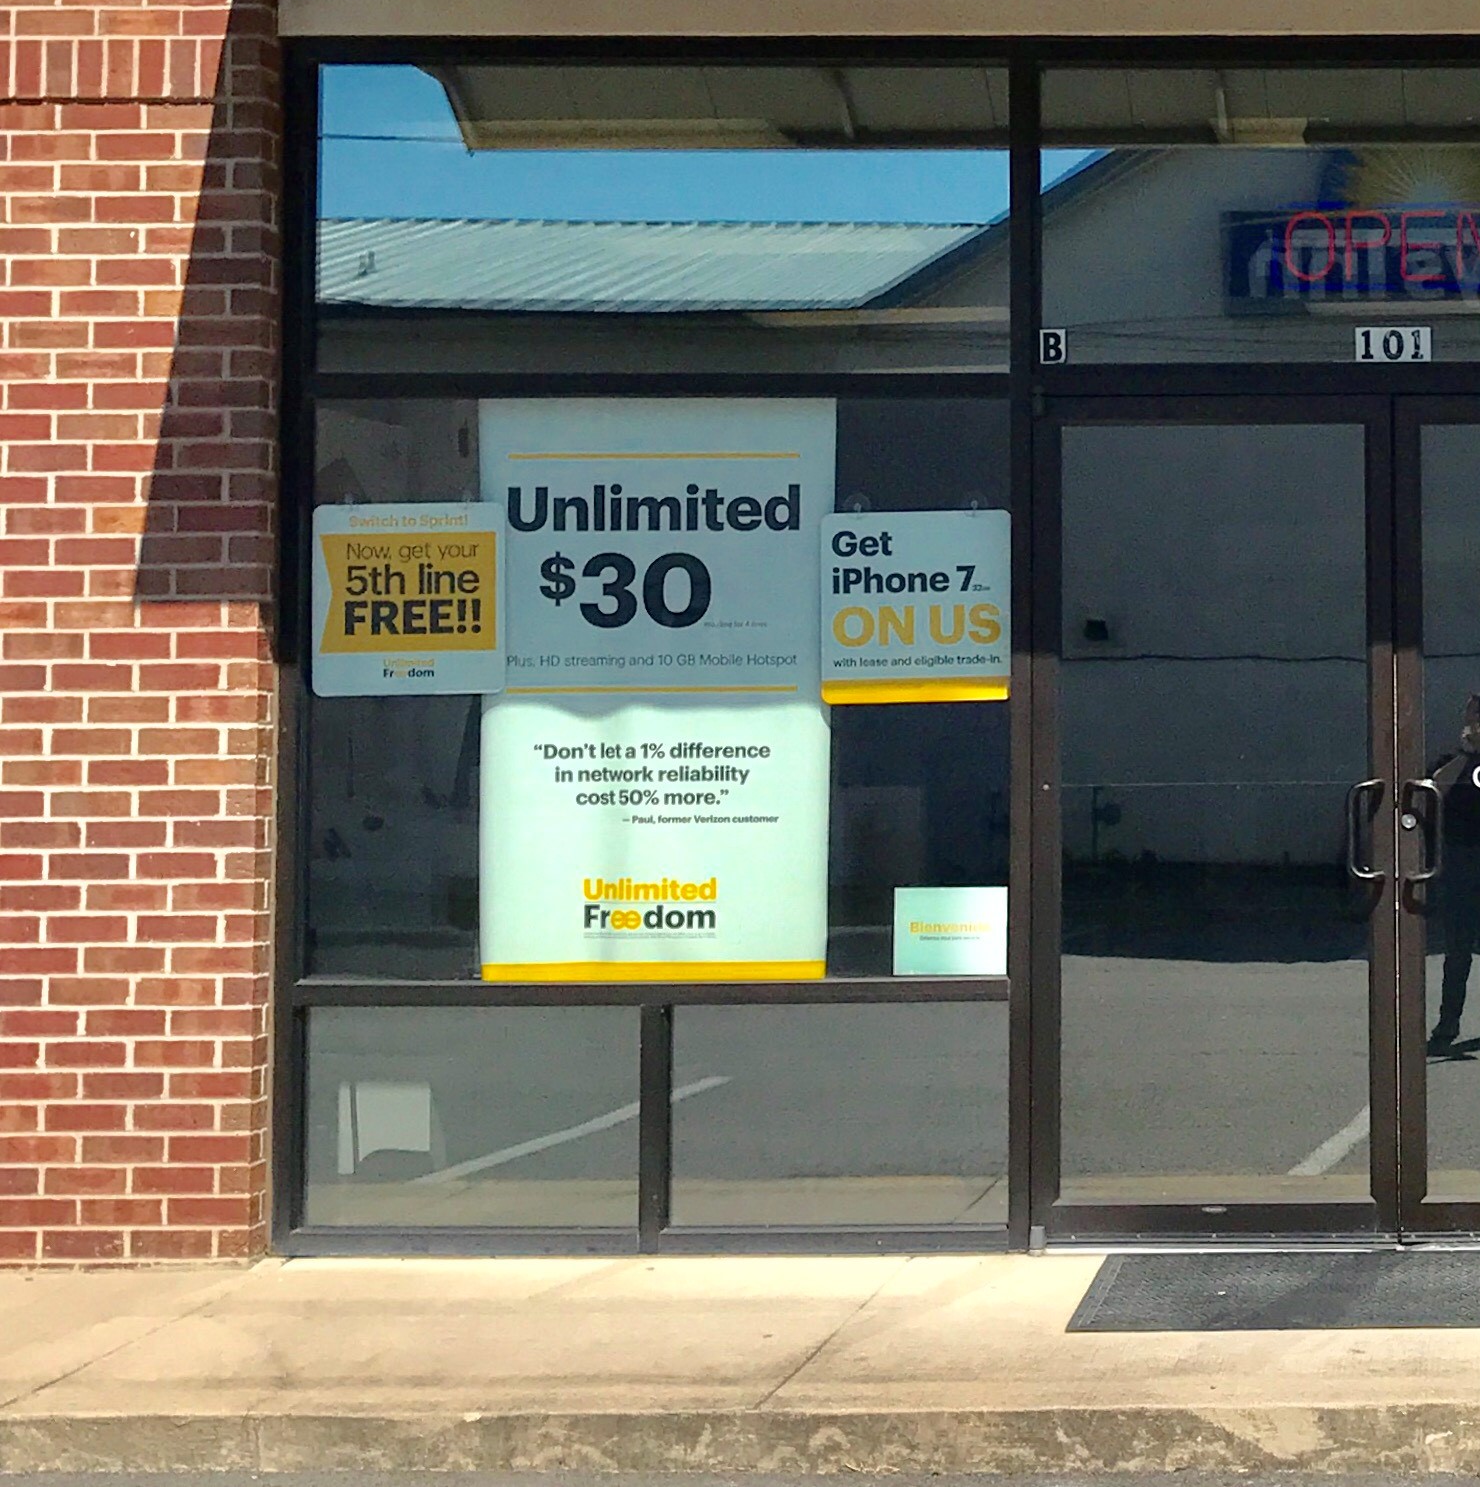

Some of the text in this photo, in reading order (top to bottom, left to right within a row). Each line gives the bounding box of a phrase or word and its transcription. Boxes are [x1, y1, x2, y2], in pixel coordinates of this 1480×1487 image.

[1043, 332, 1063, 362] B
[1360, 329, 1425, 360] 101
[349, 513, 468, 528] Switch to Sprint!
[507, 483, 800, 532] Unlimited
[346, 543, 479, 563] Now, get your
[832, 530, 893, 557] Get
[345, 563, 480, 596] 5th line
[540, 551, 712, 628] $30
[832, 565, 950, 594] iPhone
[956, 565, 976, 592] 7
[344, 598, 481, 635] FREE!!
[832, 603, 1001, 648] ON US
[540, 655, 560, 666] HD
[564, 655, 625, 669] streaming
[629, 655, 654, 666] and
[657, 654, 673, 665] 10
[676, 654, 696, 666] GB
[699, 653, 743, 666] Mobile
[746, 653, 797, 668] Hotspot
[833, 653, 1002, 668] with lease and eligible trade-in.
[600, 742, 622, 759] let
[625, 747, 636, 759] a
[640, 743, 665, 759] 1%
[669, 742, 771, 759] difference
[554, 765, 750, 785] in network reliability
[575, 791, 616, 806] cost
[618, 789, 660, 806] 50%
[657, 815, 692, 824] former
[693, 815, 730, 824] Verizon
[732, 815, 779, 824] customer
[583, 877, 717, 901] Unlimited
[583, 904, 717, 930] Freedom
